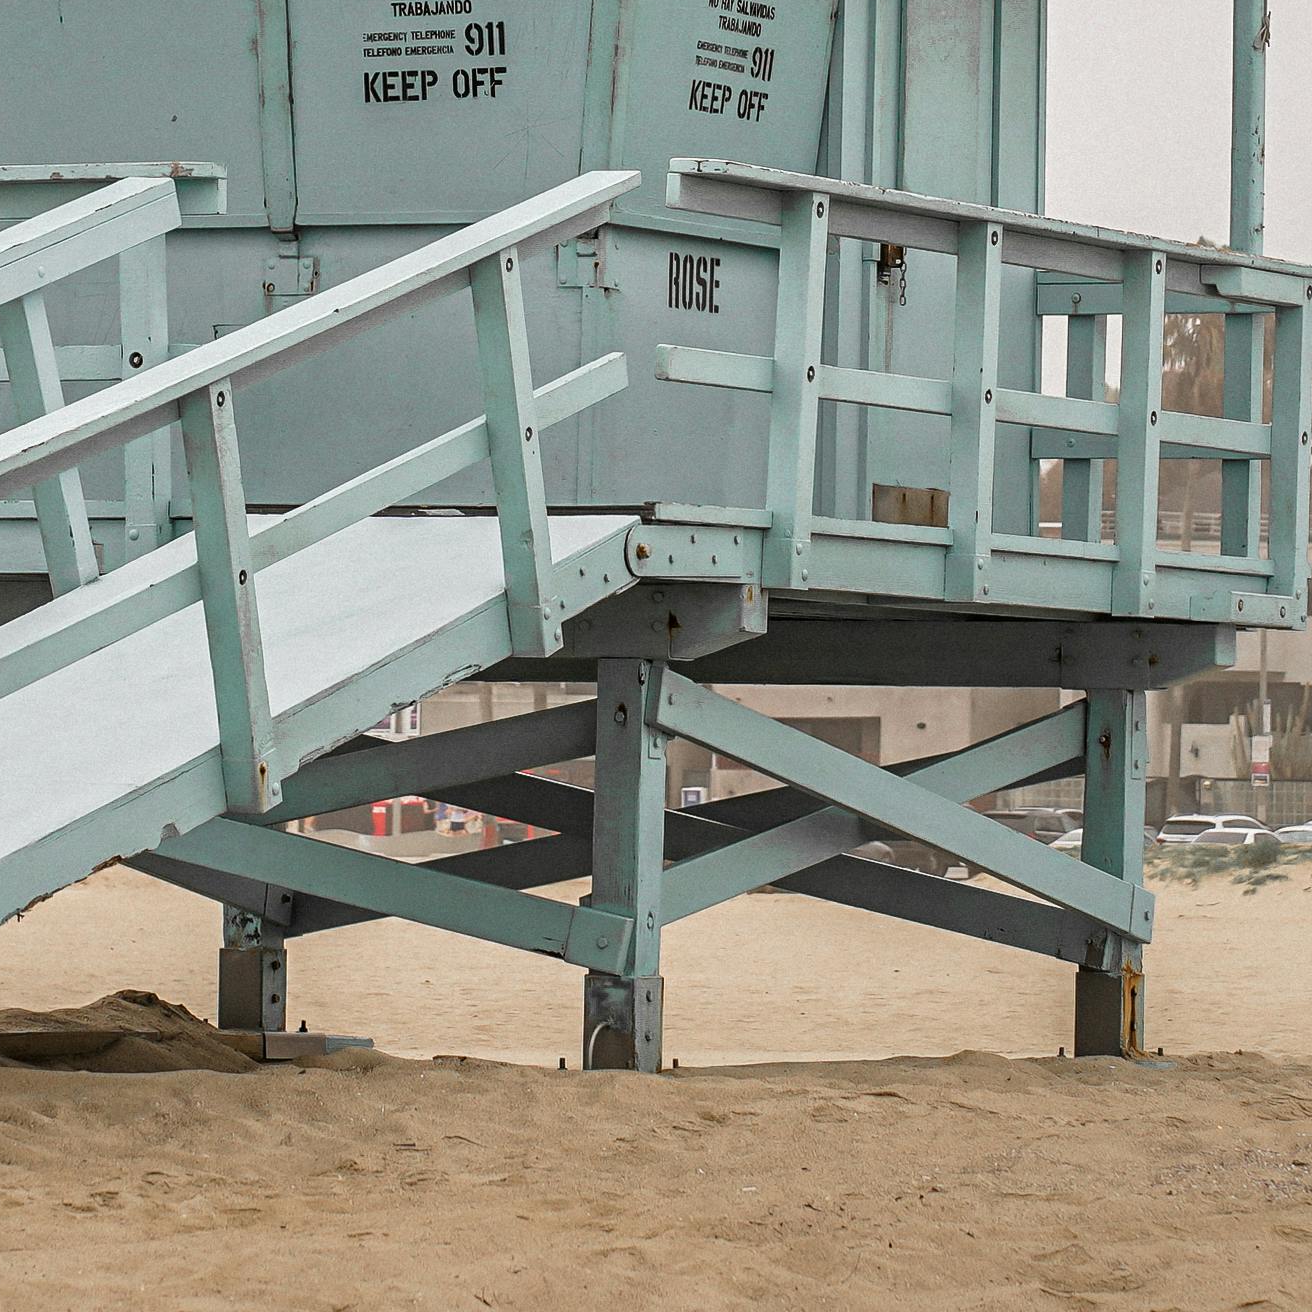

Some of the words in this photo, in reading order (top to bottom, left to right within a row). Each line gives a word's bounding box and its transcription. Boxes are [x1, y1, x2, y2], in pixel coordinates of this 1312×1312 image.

[390, 0, 472, 17] TRABAJANDO
[736, 0, 775, 20] SALVAVIDAS
[362, 31, 408, 42] EMERGENCY
[411, 29, 456, 41] TELEPHONE
[464, 21, 506, 56] 911
[718, 15, 762, 38] TRABAJANDO
[363, 46, 402, 57] TELEFONO
[405, 45, 455, 56] EMERGENCIA
[750, 46, 775, 82] 911
[363, 70, 438, 103] KEEP
[452, 66, 507, 98] OFF
[688, 79, 732, 114] KEEP
[737, 89, 768, 122] OFF
[668, 252, 720, 314] ROSE
